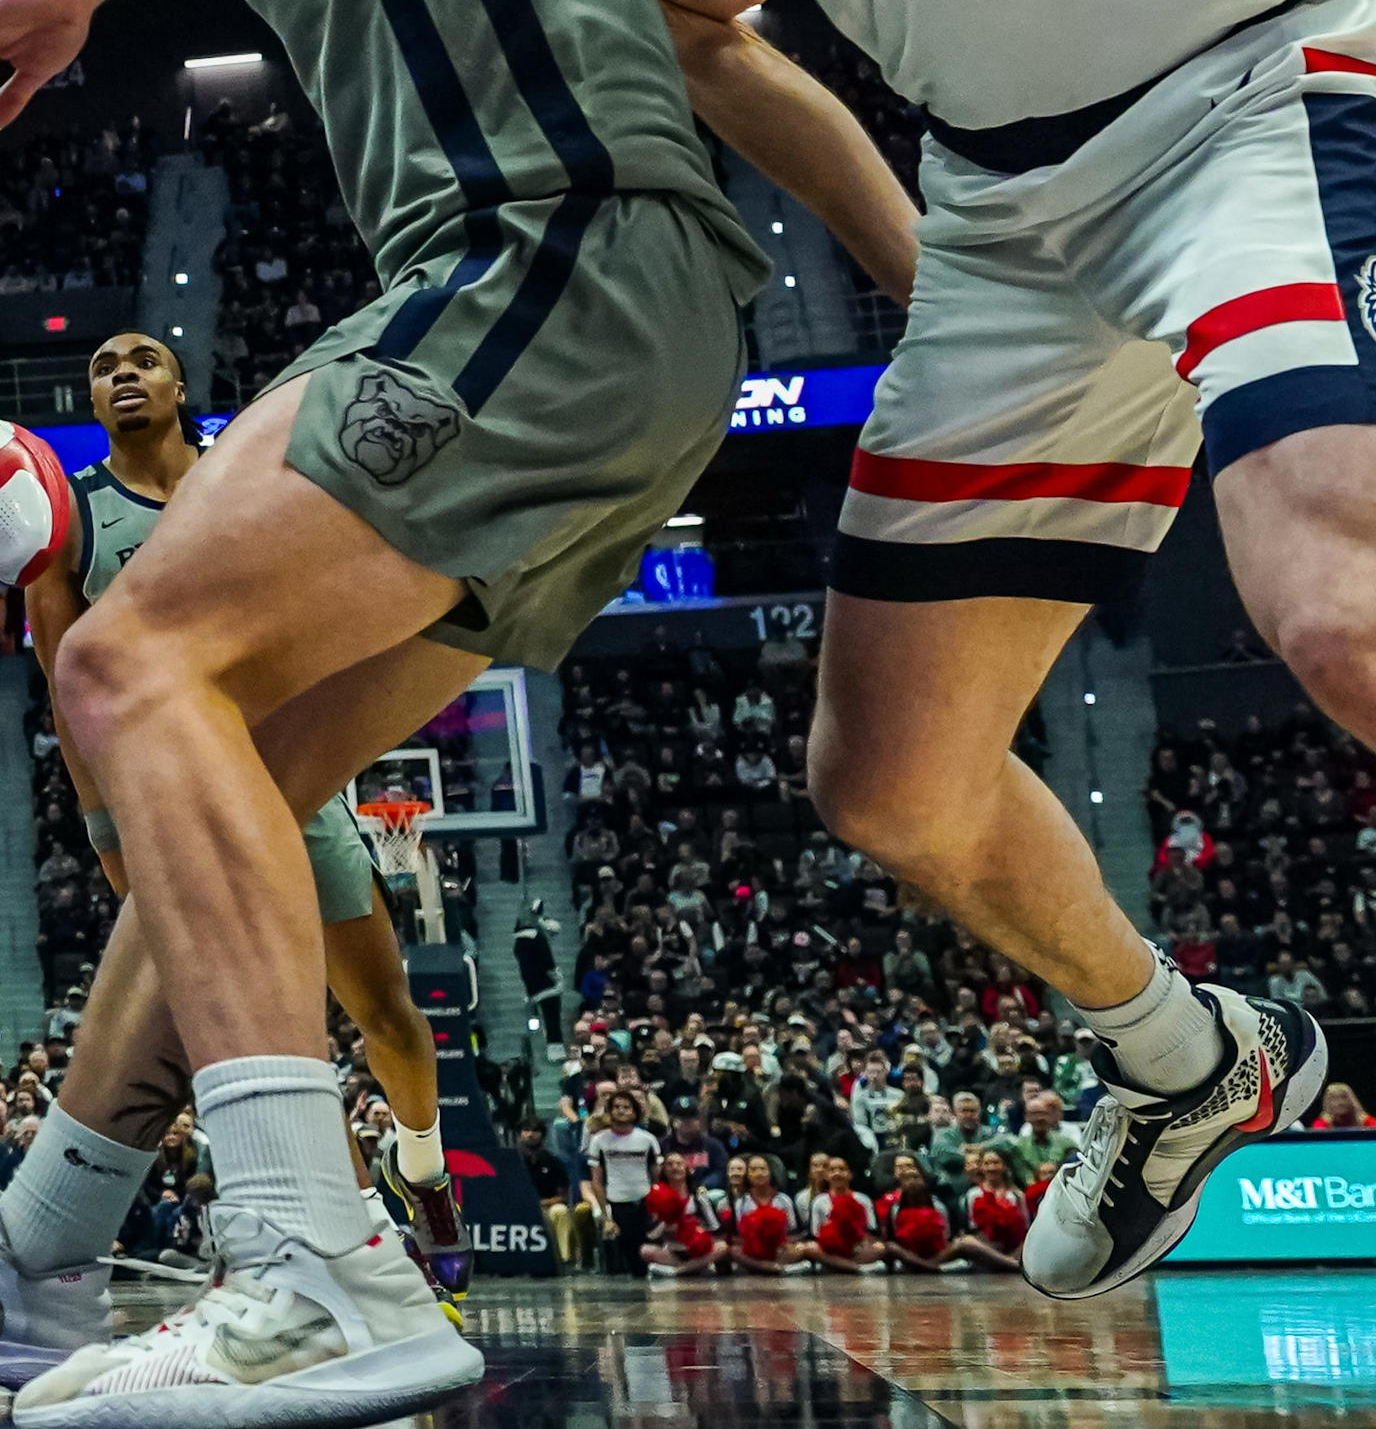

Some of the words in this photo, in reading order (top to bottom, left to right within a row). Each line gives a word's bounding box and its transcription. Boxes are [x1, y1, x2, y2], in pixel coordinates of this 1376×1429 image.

[731, 407, 806, 427] NING
[1237, 1176, 1323, 1211] M&T
[1323, 1175, 1376, 1209] Ban
[468, 1223, 548, 1254] LERS
